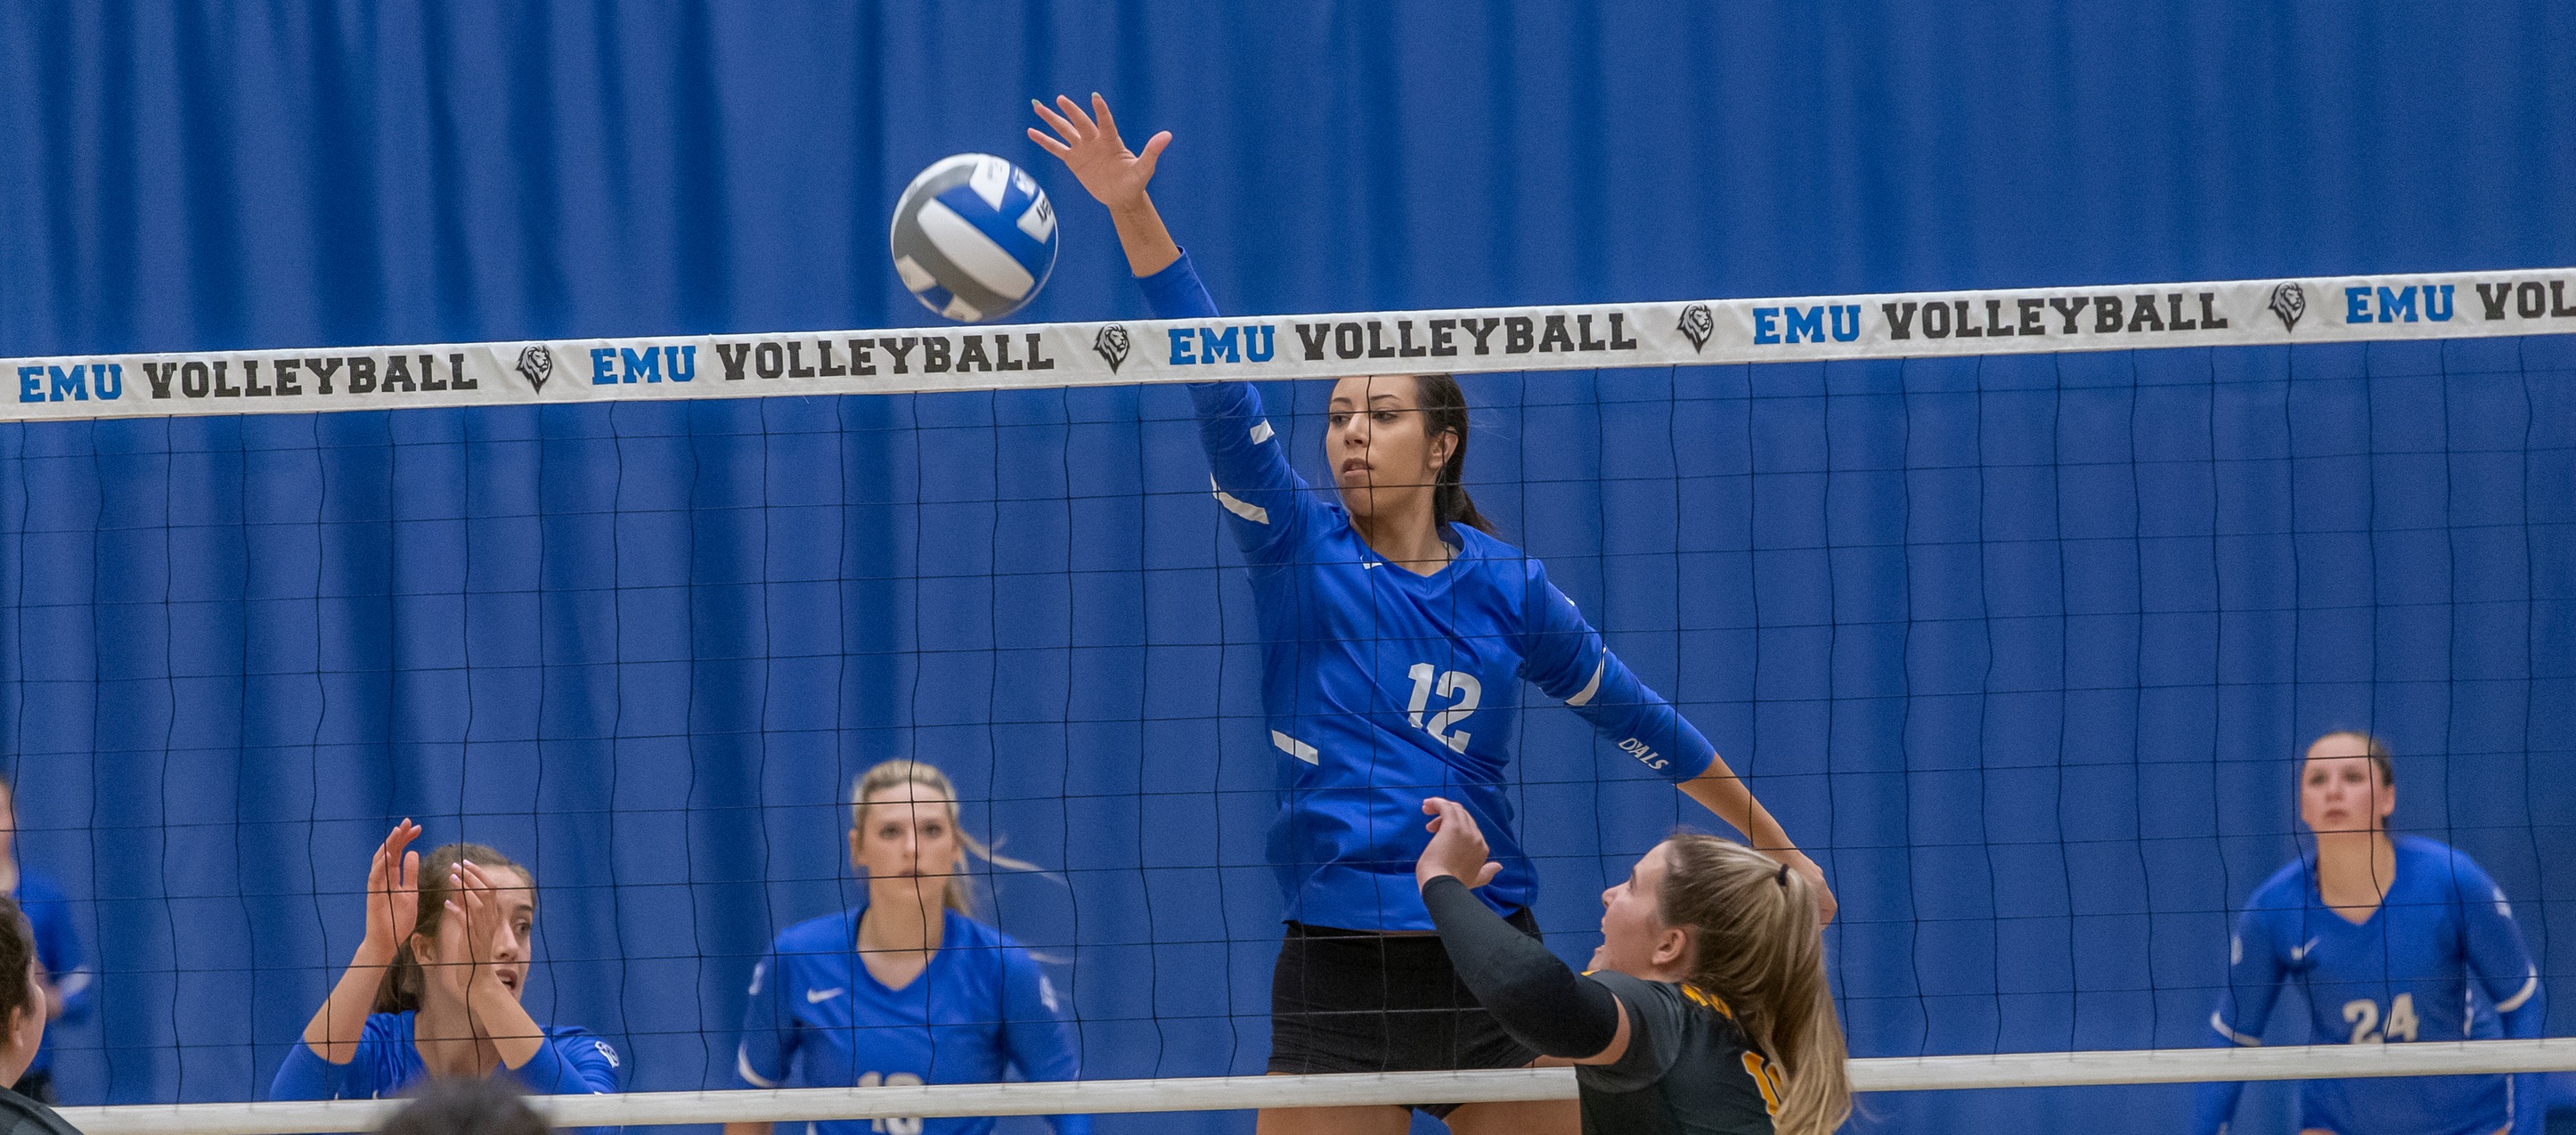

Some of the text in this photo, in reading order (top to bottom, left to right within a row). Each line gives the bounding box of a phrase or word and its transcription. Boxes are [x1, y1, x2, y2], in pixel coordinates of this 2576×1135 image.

[1753, 293, 2228, 345] EMU VOLLEYBALL
[2345, 281, 2576, 323] EMU VOL
[591, 333, 1054, 385] EMU VOLLEYBALL
[1169, 314, 1636, 365] EMU VOLLEYBALL
[18, 354, 477, 403] EMU VOLLEYBALL
[1408, 663, 1481, 755] 12
[2343, 992, 2419, 1044] 24
